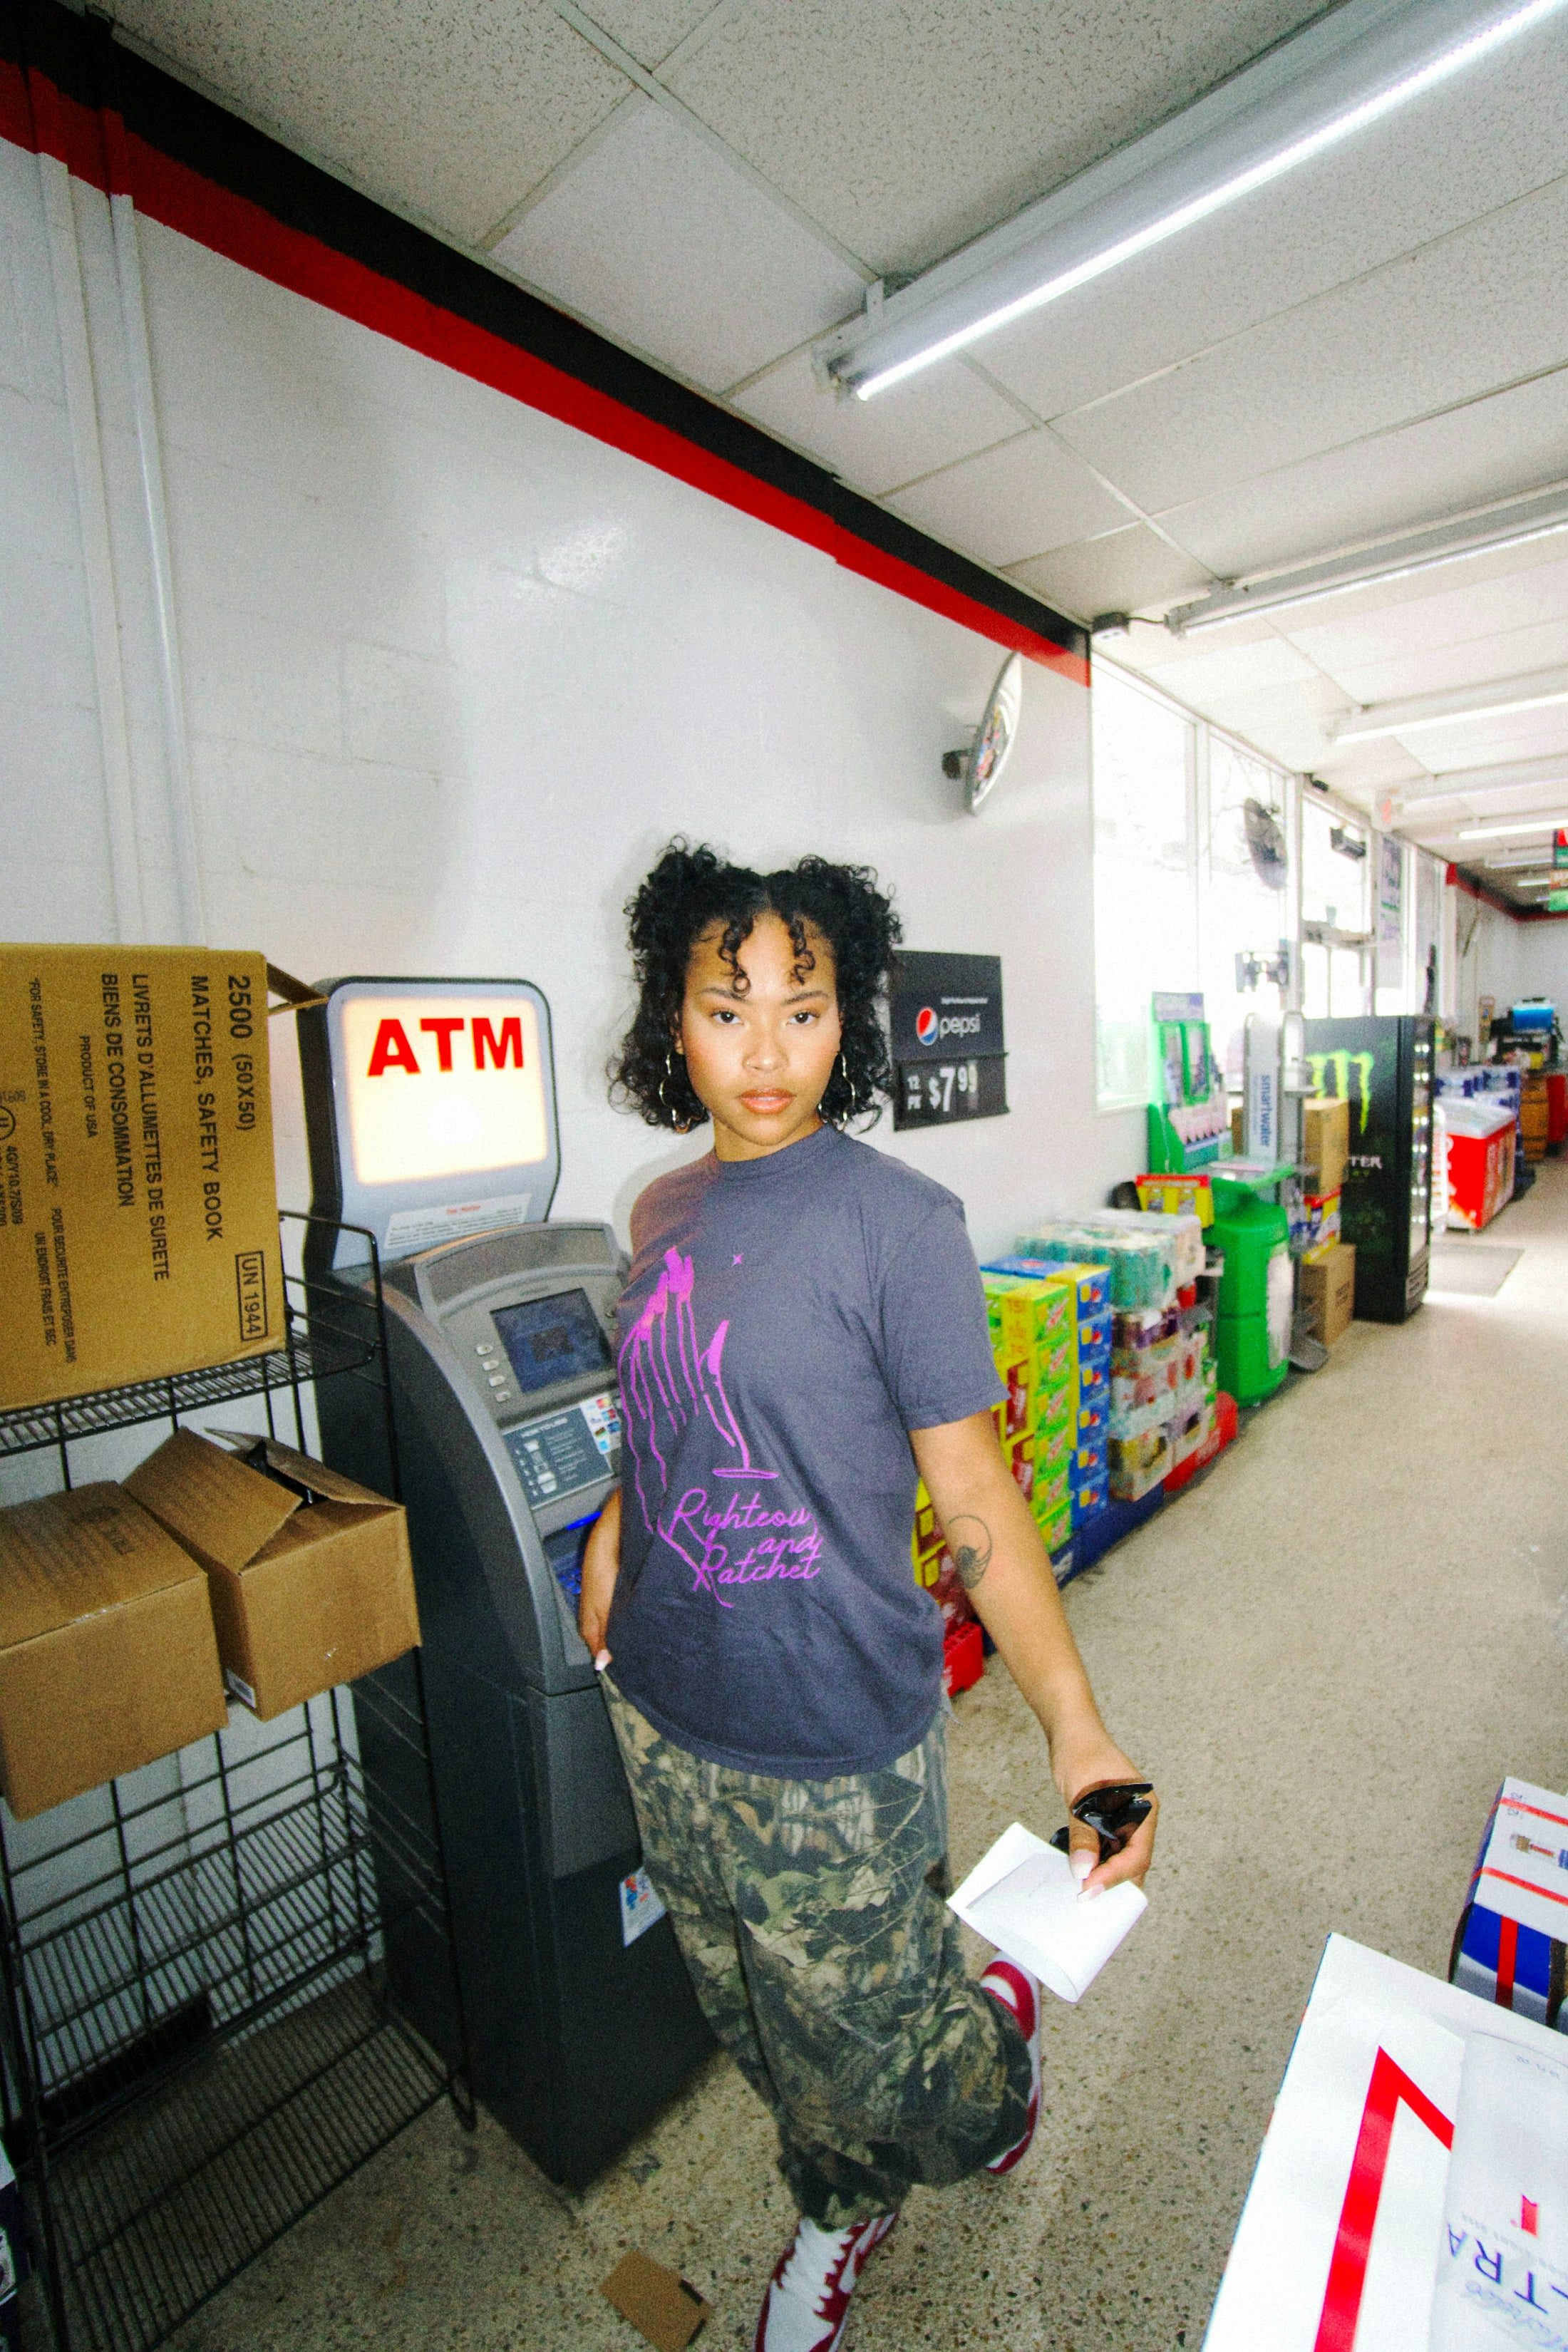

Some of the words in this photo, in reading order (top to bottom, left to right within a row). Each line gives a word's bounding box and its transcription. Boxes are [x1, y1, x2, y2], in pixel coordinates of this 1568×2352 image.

[101, 973, 121, 1028] BIENS
[132, 974, 153, 1047] LIVRETS
[228, 975, 254, 1039] 2500
[939, 1013, 981, 1039] pepsi
[106, 1032, 123, 1057] DE
[191, 976, 214, 1085] MATCHES,
[367, 1017, 524, 1078] ATM
[34, 1045, 48, 1080] STORE
[38, 1079, 49, 1089] IN
[79, 1035, 94, 1092] PRODUCT
[83, 1095, 96, 1110] OF
[138, 1052, 162, 1183] D'ALLUMETTES
[232, 1053, 256, 1131] (50X50)
[1261, 1075, 1272, 1147] smartwater
[42, 1131, 55, 1150] DRY
[86, 1114, 98, 1138] USA
[108, 1061, 135, 1207] CONSOMMATION
[197, 1093, 219, 1172] SAFETY
[52, 1208, 64, 1234] POUR
[148, 1187, 164, 1211] DE
[202, 1182, 223, 1241] BOOK
[34, 1232, 46, 1245] UN
[149, 1215, 170, 1281] SURETE
[242, 1257, 259, 1285] UN
[244, 1292, 264, 1336] 1944
[757, 1535, 824, 1555] and
[692, 1544, 822, 1609] Ratchet
[1447, 2220, 1568, 2315] TRA
